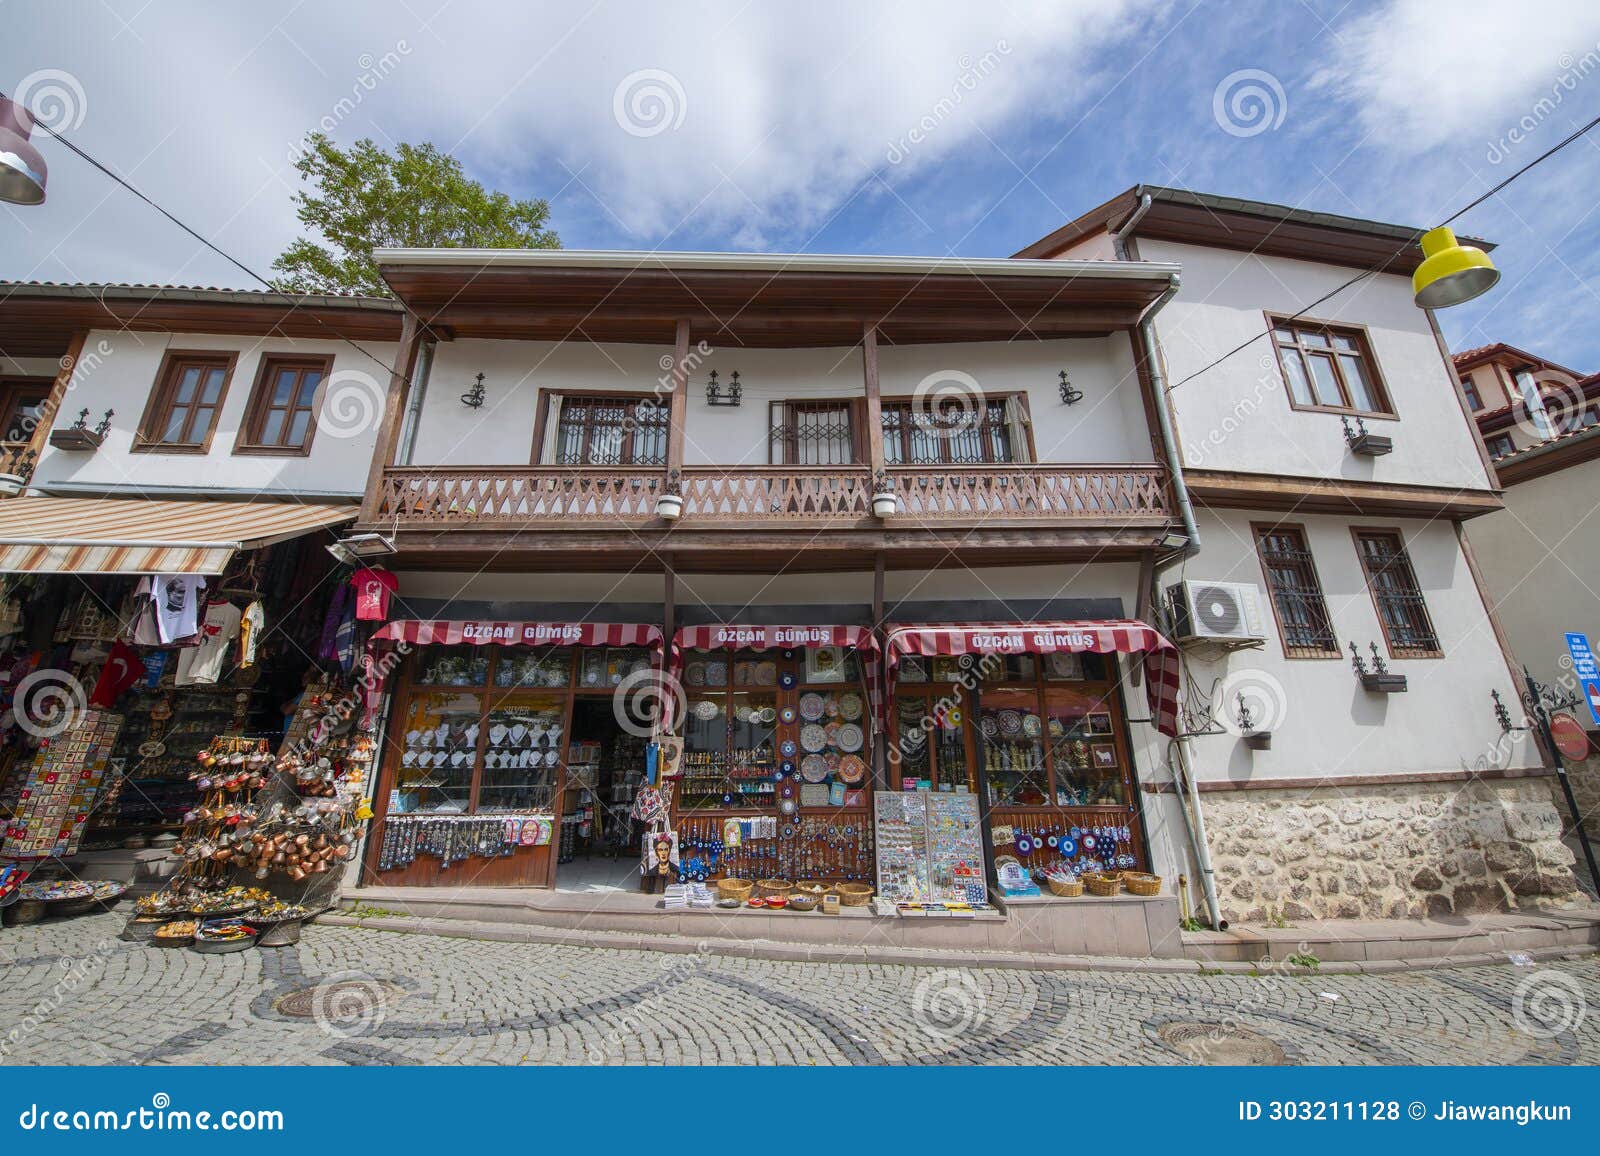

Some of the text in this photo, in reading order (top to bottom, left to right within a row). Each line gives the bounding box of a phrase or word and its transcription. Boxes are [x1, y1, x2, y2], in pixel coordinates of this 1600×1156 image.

[463, 624, 583, 641] ÖZCAN GÜMÜŞ
[718, 628, 830, 643] ÖZCAN GÜMÜŞ
[972, 630, 1095, 648] ÖZCAN GÜMÜŞ
